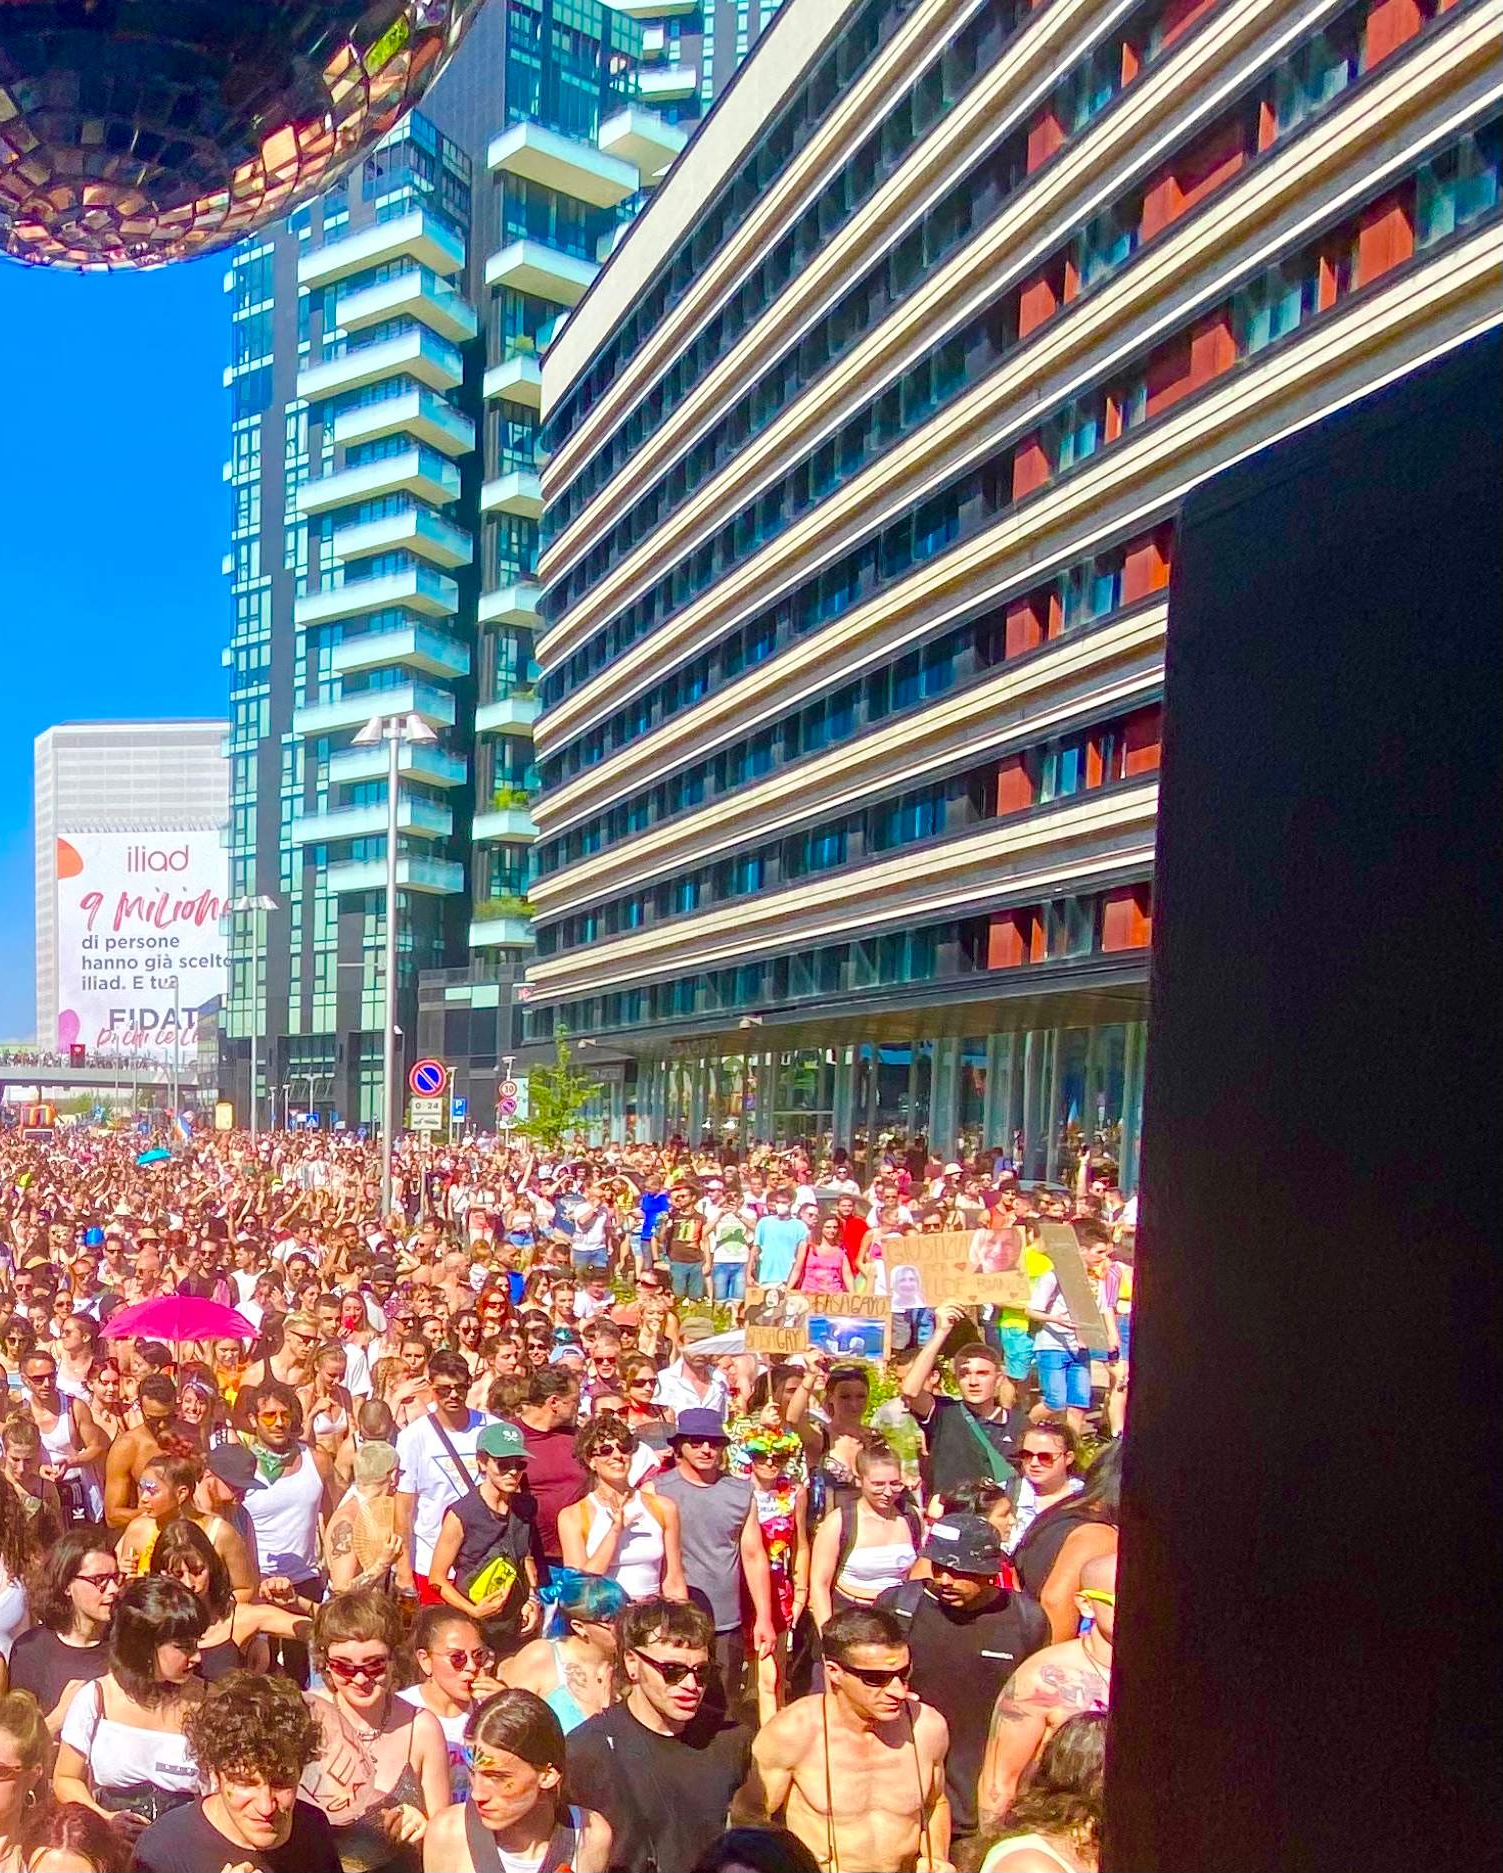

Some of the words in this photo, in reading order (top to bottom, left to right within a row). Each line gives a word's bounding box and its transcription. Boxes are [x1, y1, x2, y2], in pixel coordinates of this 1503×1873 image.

[127, 845, 190, 872] iliad
[80, 892, 104, 932] 9
[82, 934, 99, 950] di
[105, 936, 180, 953] persone
[82, 955, 139, 970] hanno
[145, 953, 173, 972] già
[82, 975, 126, 991] iliad.
[133, 976, 144, 990] E
[150, 974, 179, 990] tu?
